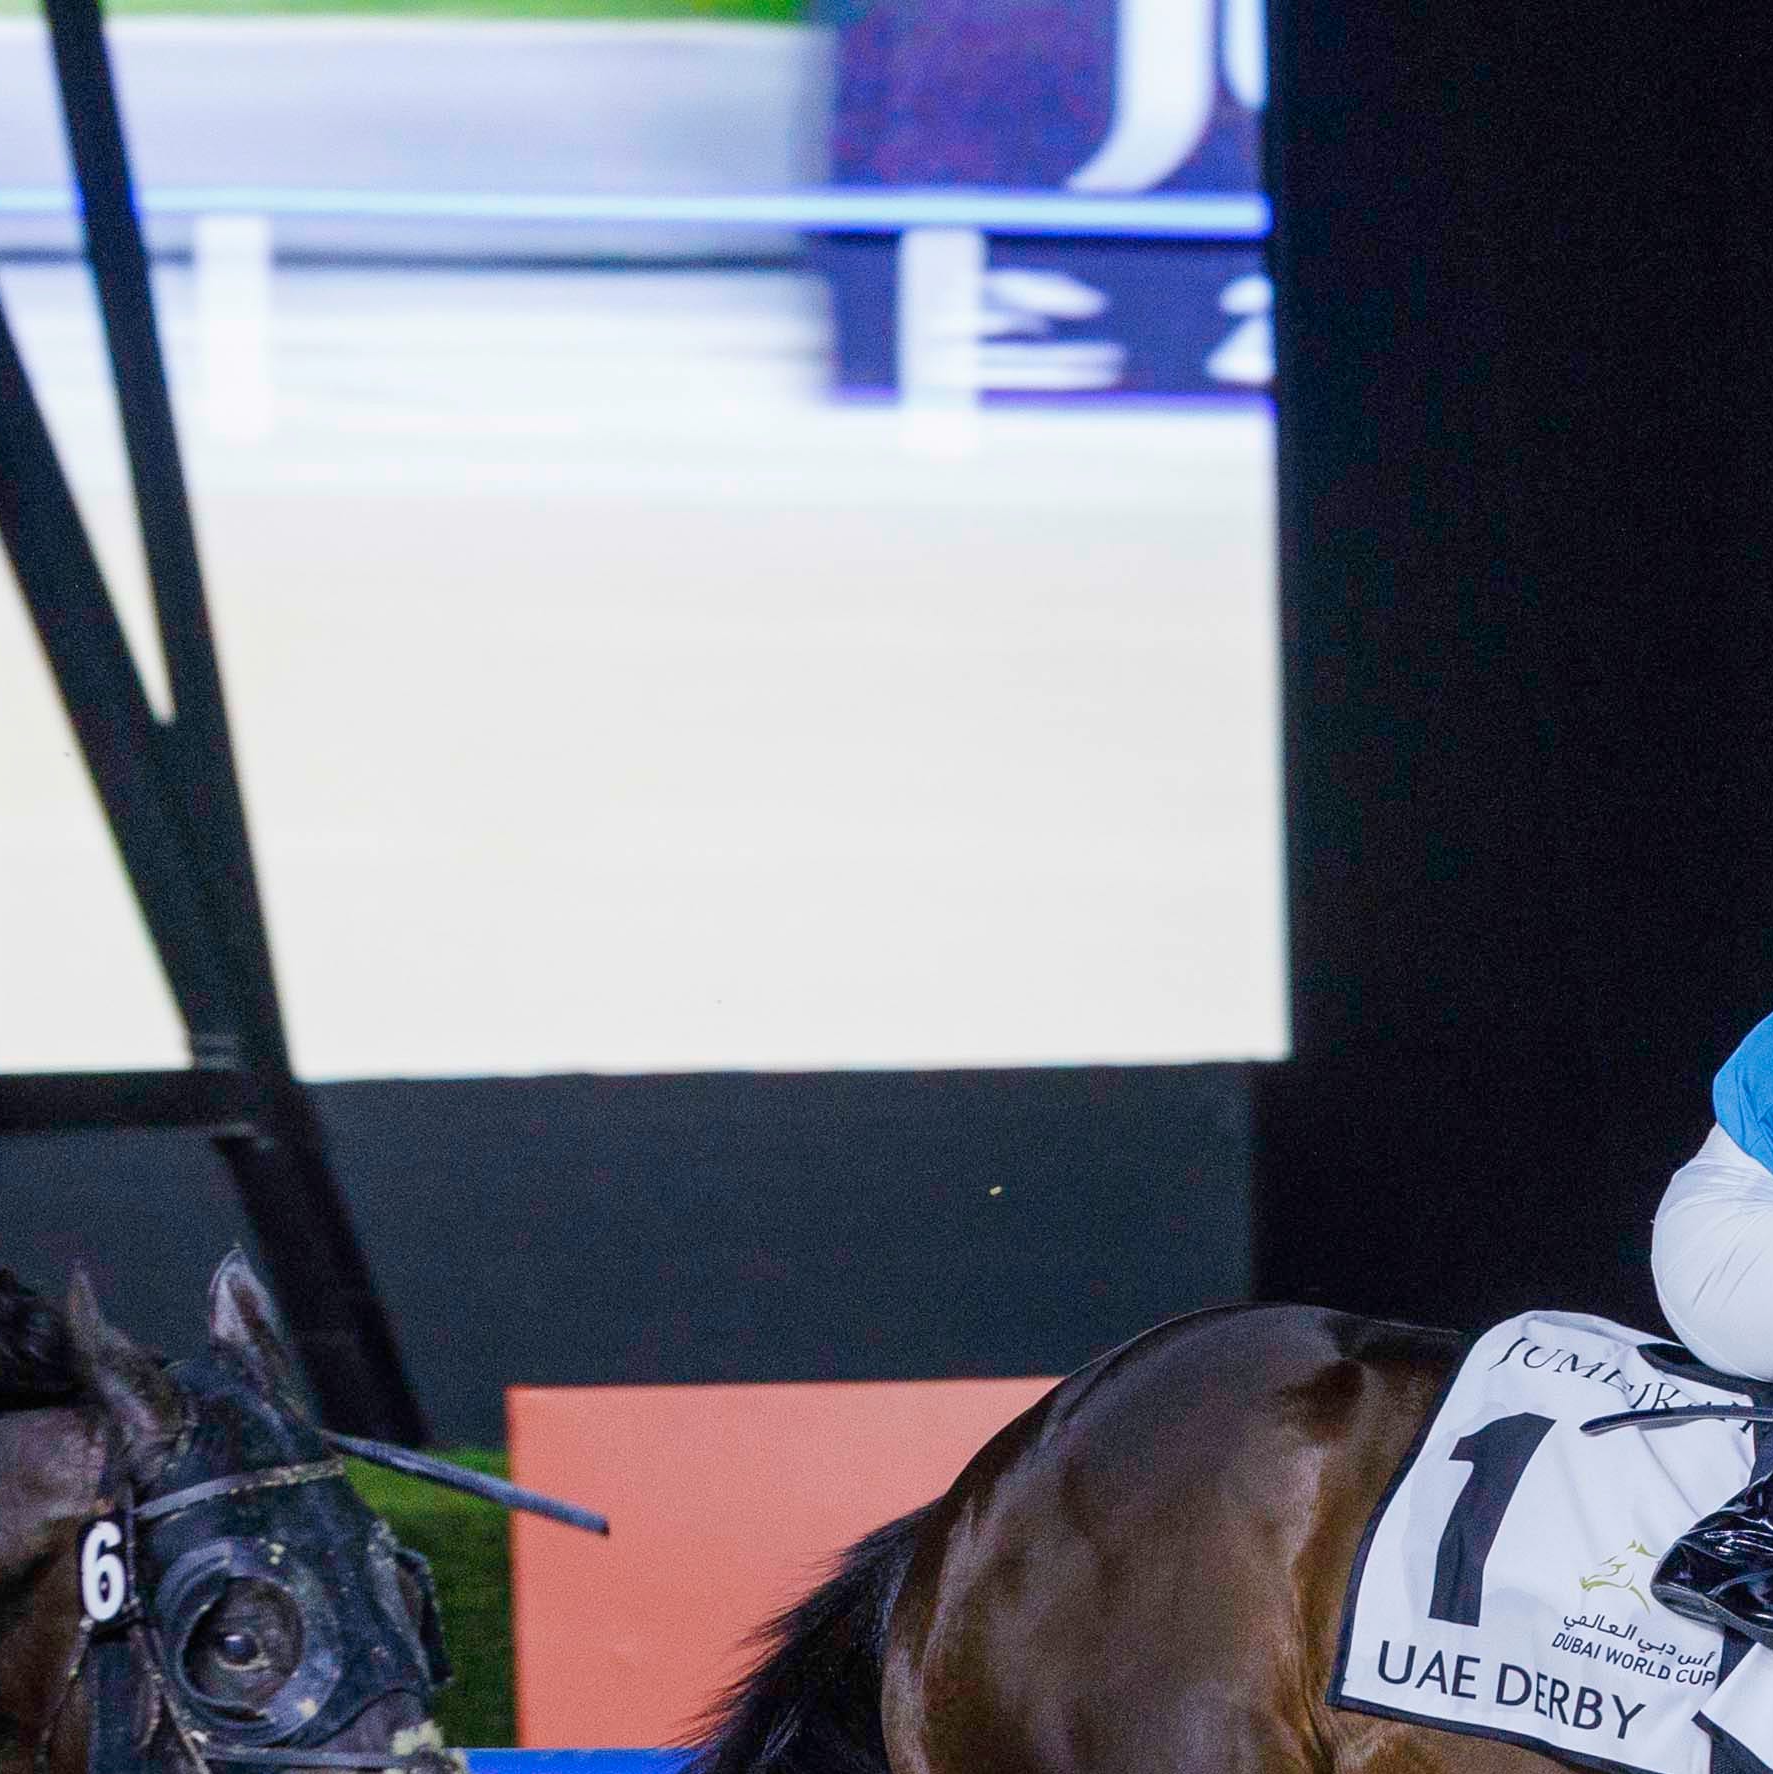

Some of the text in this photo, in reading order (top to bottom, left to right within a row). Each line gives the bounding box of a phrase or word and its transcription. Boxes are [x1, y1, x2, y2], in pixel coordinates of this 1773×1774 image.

[1488, 1336, 1754, 1434] JUMEIR
[1428, 1412, 1557, 1628] 1
[81, 1520, 126, 1622] 6
[1377, 1639, 1647, 1740] UAE DERBY
[1551, 1631, 1716, 1687] DUBAI WORLD CUP
